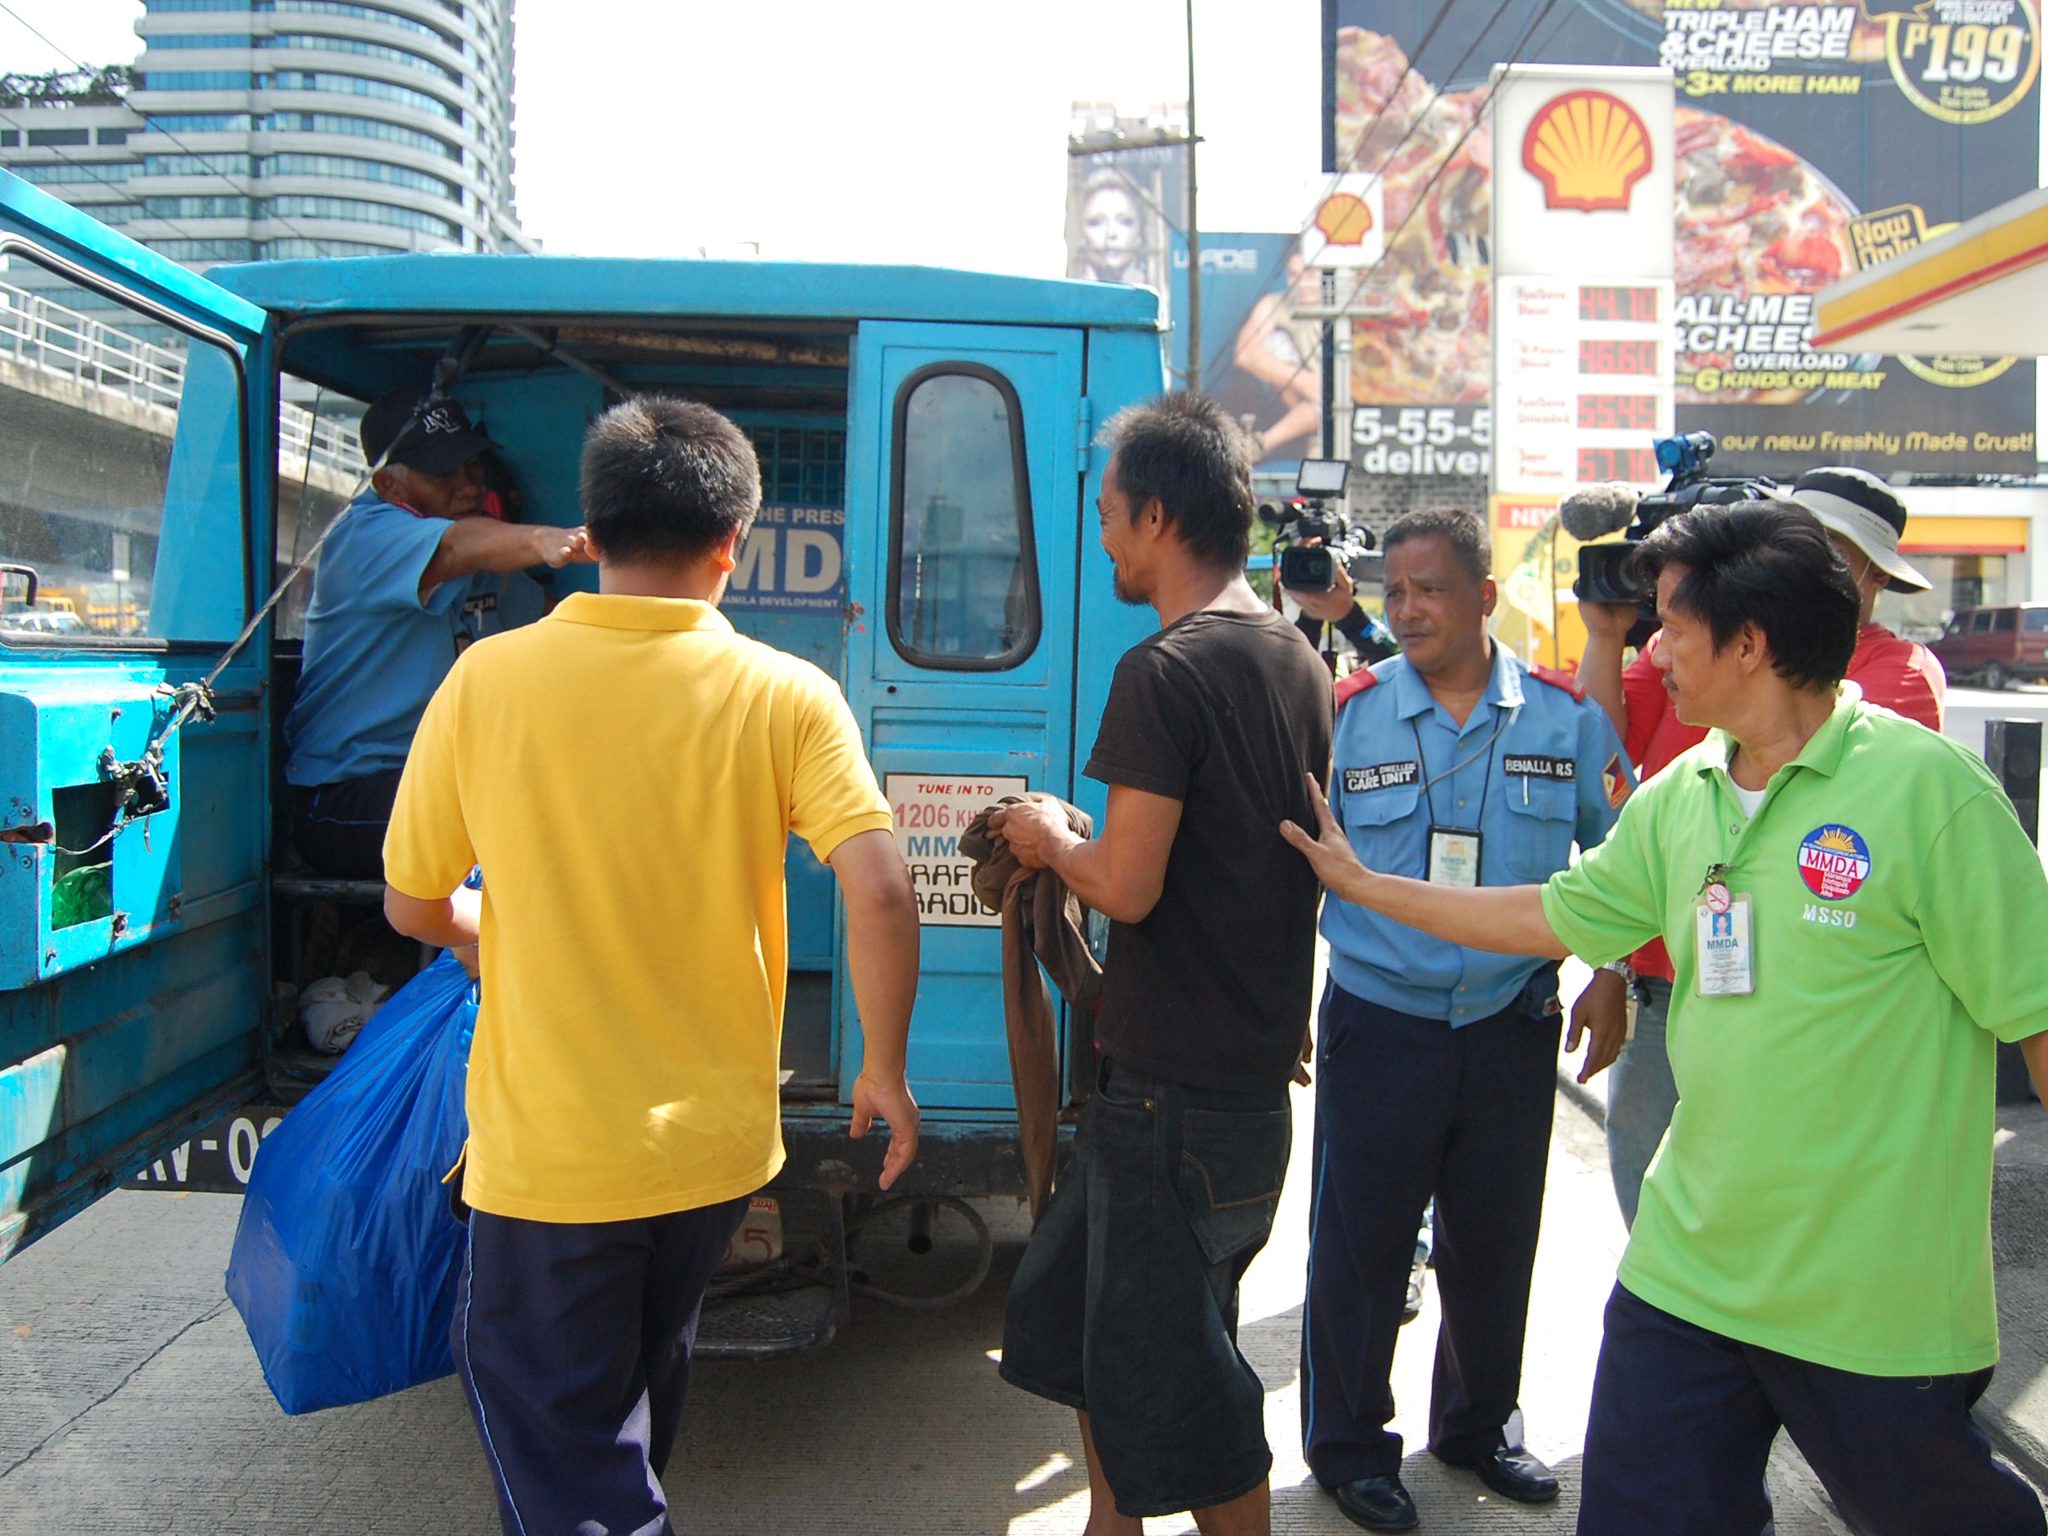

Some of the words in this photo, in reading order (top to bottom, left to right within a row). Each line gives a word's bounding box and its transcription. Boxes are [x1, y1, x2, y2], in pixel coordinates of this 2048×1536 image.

[1662, 11, 1767, 32] TRIPLE
[1766, 7, 1855, 32] HAM
[1660, 55, 1771, 71] OVERLOAD
[1732, 75, 1804, 94] MORE
[1806, 75, 1862, 95] HAM
[1851, 211, 1912, 248] Now
[1676, 294, 1814, 325] ALL-ME
[1734, 353, 1848, 371] OVERLOAD
[1694, 368, 1721, 393] 6
[1721, 372, 1791, 390] KINDS
[1792, 372, 1823, 390] OF
[1824, 371, 1887, 390] MEAT
[1721, 435, 1758, 450] our
[1764, 435, 1817, 450] new
[1820, 430, 1901, 456] Freshly
[1905, 431, 1969, 451] Made
[1974, 431, 2035, 451] Crust!
[758, 507, 785, 523] HE
[729, 527, 845, 593] MD
[722, 595, 757, 606] ANILA
[759, 596, 839, 608] DEVELOPMENT
[917, 784, 953, 795] TUNE
[957, 785, 972, 795] IN
[977, 785, 994, 796] TO
[1347, 775, 1380, 791] CARE
[1381, 770, 1414, 786] UNIT
[895, 803, 950, 828] 1206
[956, 809, 984, 828] KH
[907, 836, 966, 857] MM
[1806, 848, 1858, 878] MMDA
[906, 864, 974, 886] RAF
[1802, 903, 1857, 928] MSSO
[1707, 938, 1739, 950] MMDA
